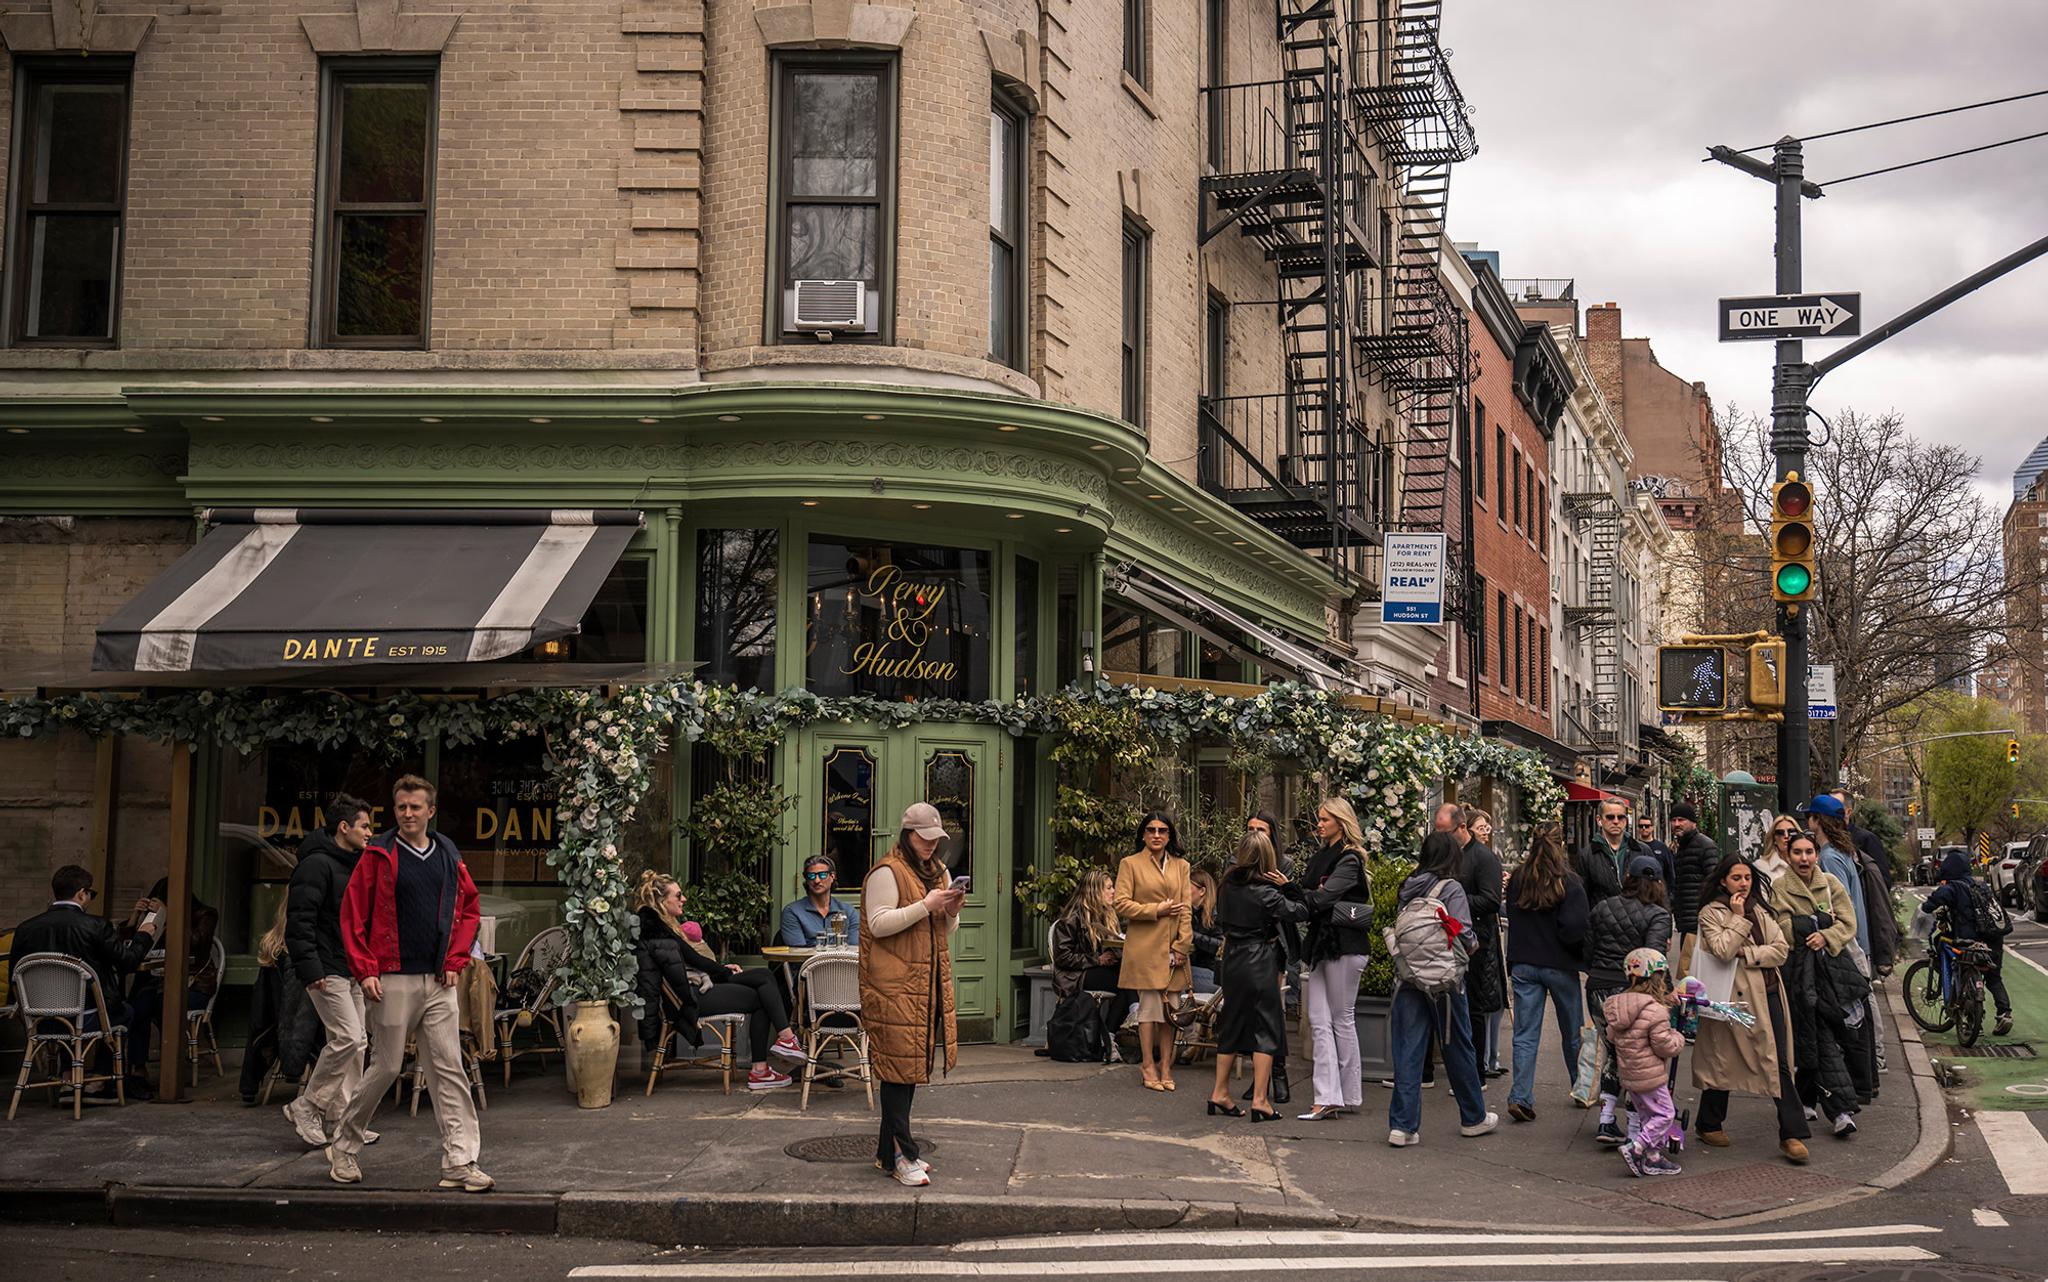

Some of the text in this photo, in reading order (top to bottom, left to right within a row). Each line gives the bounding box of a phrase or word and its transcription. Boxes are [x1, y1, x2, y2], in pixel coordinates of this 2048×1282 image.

[1740, 308, 1839, 328] ONE WAY
[857, 564, 946, 621] Perry
[887, 607, 928, 648] &
[283, 636, 448, 660] DANTE EST 1915
[839, 641, 959, 682] Hudson
[298, 790, 319, 800] EST
[258, 806, 386, 840] DANE
[475, 807, 553, 841] DAN
[496, 848, 551, 857] NEW YOR
